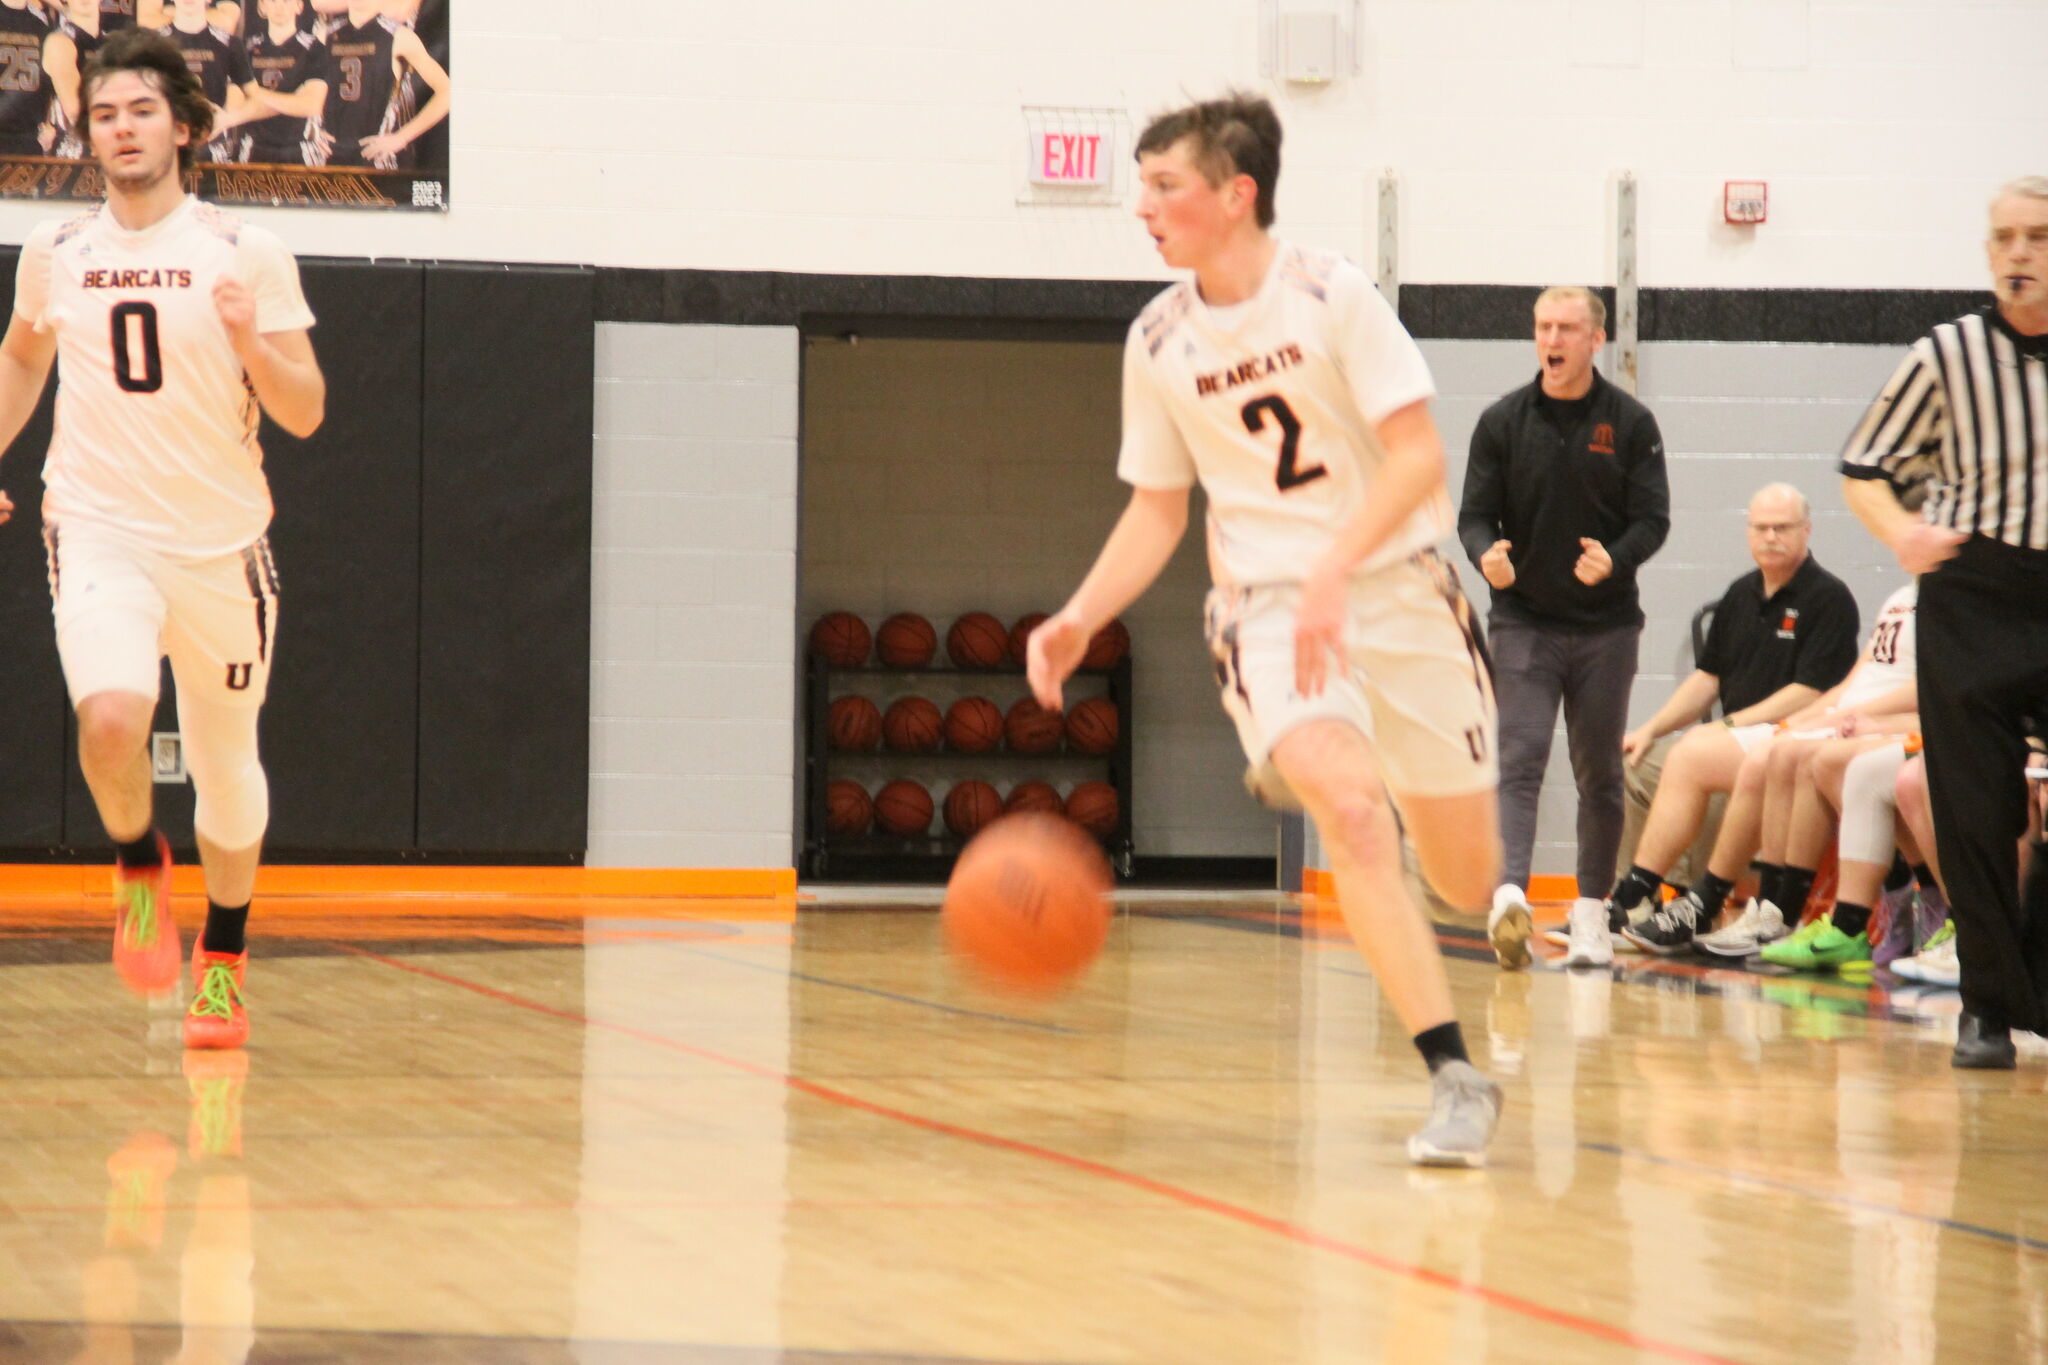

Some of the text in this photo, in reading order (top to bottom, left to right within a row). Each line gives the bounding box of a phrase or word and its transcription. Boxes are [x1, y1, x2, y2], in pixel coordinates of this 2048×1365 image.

[339, 56, 362, 102] 3
[1044, 133, 1101, 179] EXIT
[214, 170, 397, 207] BASKETBALL
[83, 269, 192, 288] BEARCATS
[110, 300, 162, 393] 0
[1196, 344, 1303, 396] BEARCATS
[1241, 394, 1328, 493] 2
[225, 663, 252, 690] U
